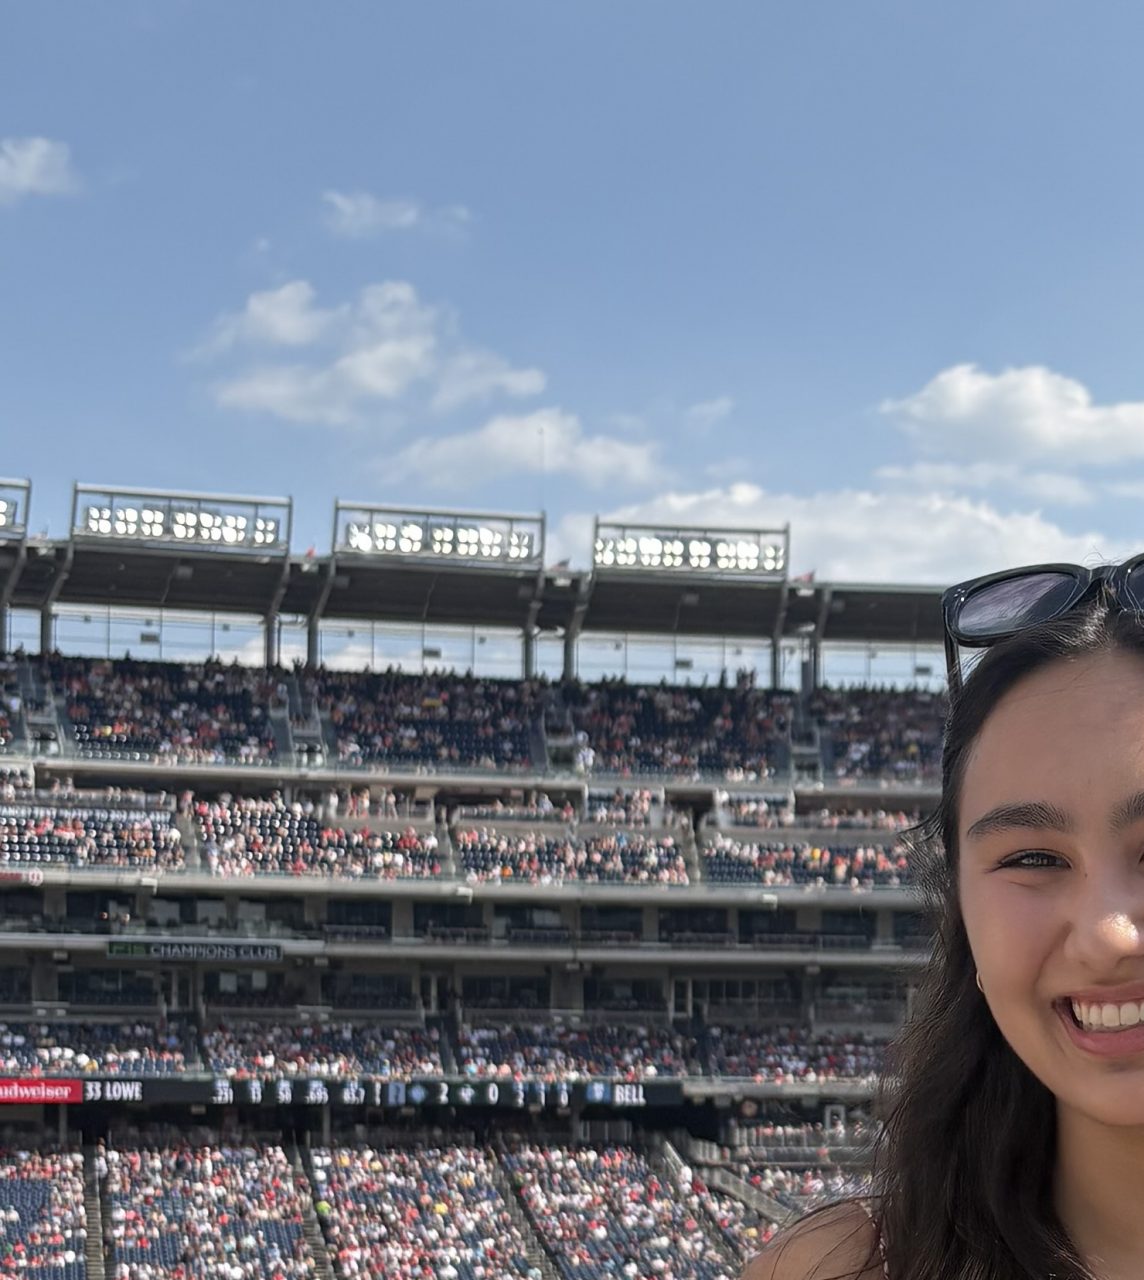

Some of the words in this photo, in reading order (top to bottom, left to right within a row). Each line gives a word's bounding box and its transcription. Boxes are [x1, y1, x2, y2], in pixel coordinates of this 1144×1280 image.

[151, 944, 236, 959] CHAMPIONS
[239, 947, 278, 960] CLUB
[0, 1082, 72, 1099] udweiser
[86, 1081, 101, 1100] 33
[105, 1081, 142, 1101] LOWE
[615, 1084, 647, 1106] BELL
